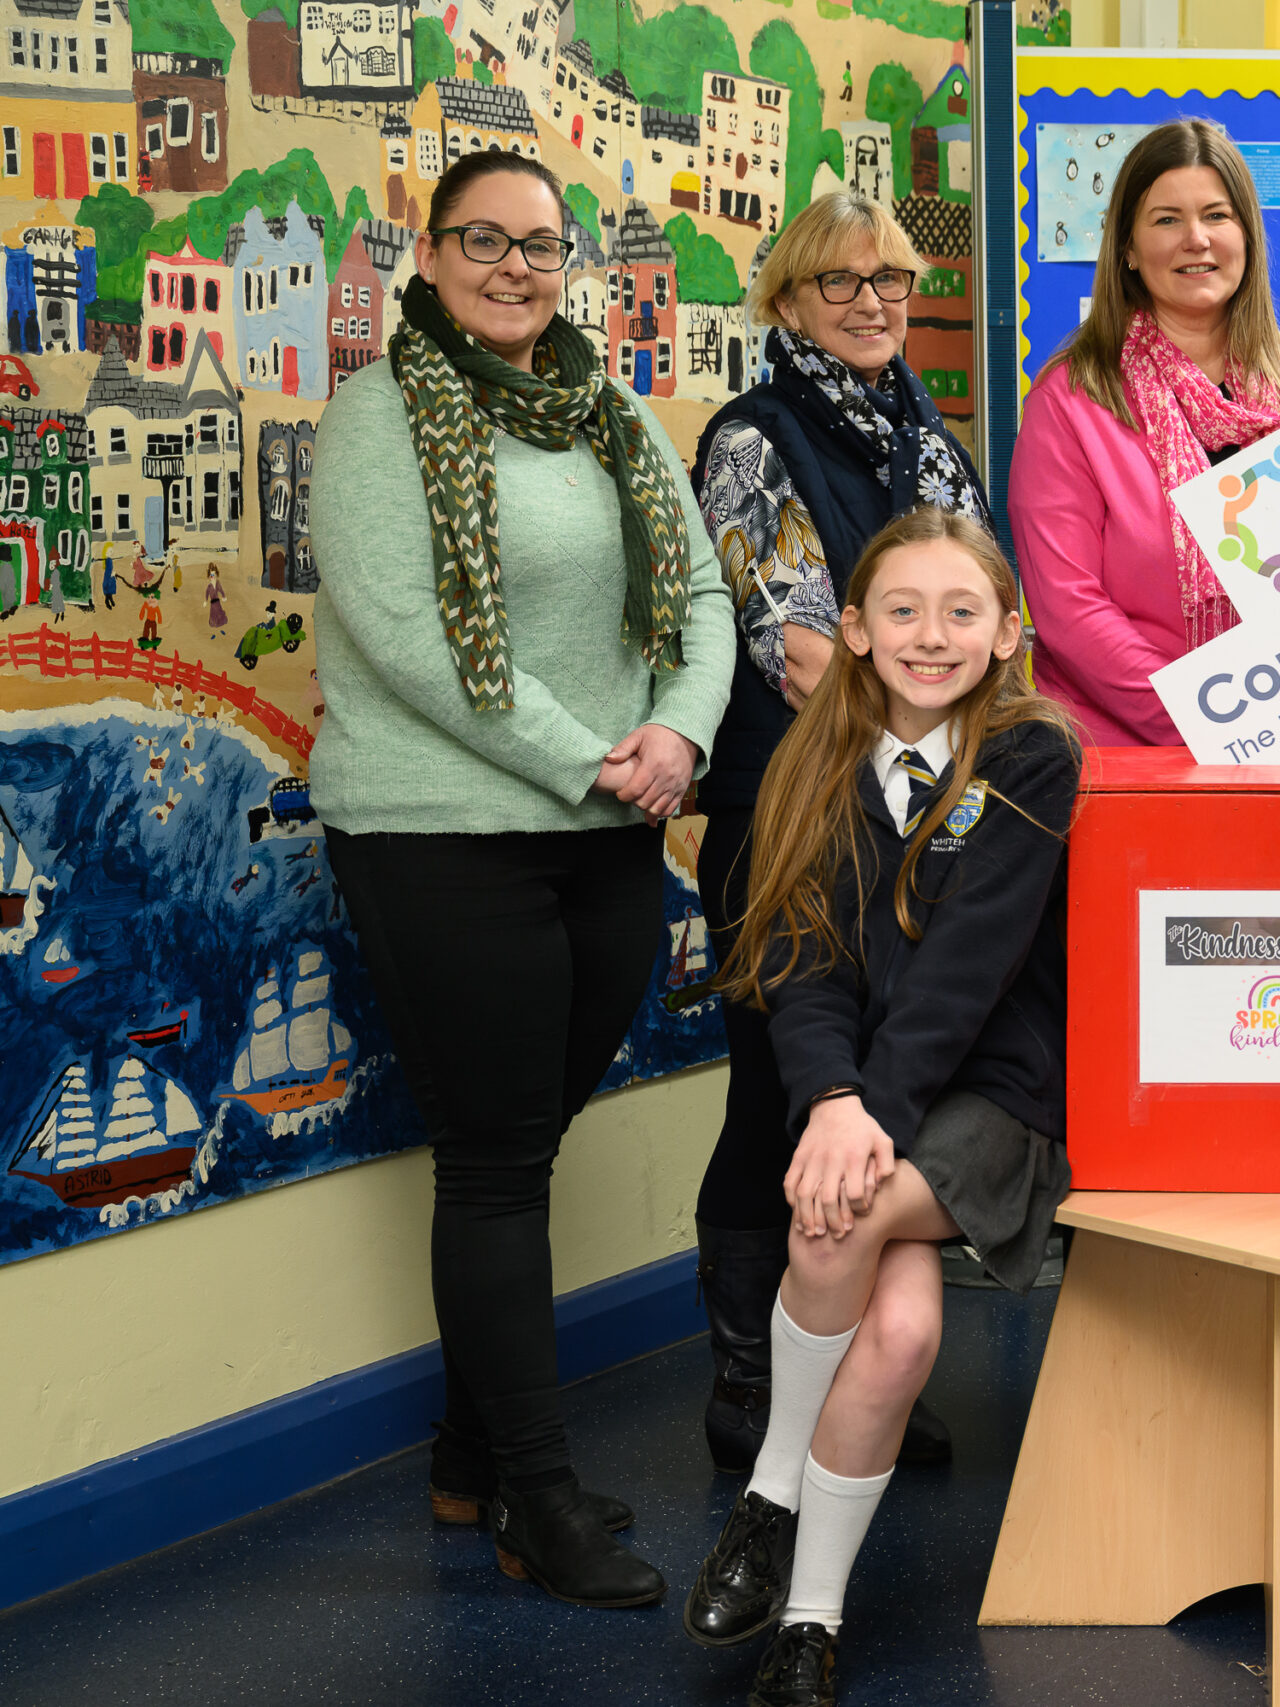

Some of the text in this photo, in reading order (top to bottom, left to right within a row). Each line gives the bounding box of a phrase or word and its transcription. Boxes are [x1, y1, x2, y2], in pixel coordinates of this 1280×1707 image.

[23, 227, 81, 250] GARAGE
[1223, 730, 1276, 764] The
[64, 1168, 112, 1193] ASTRID
